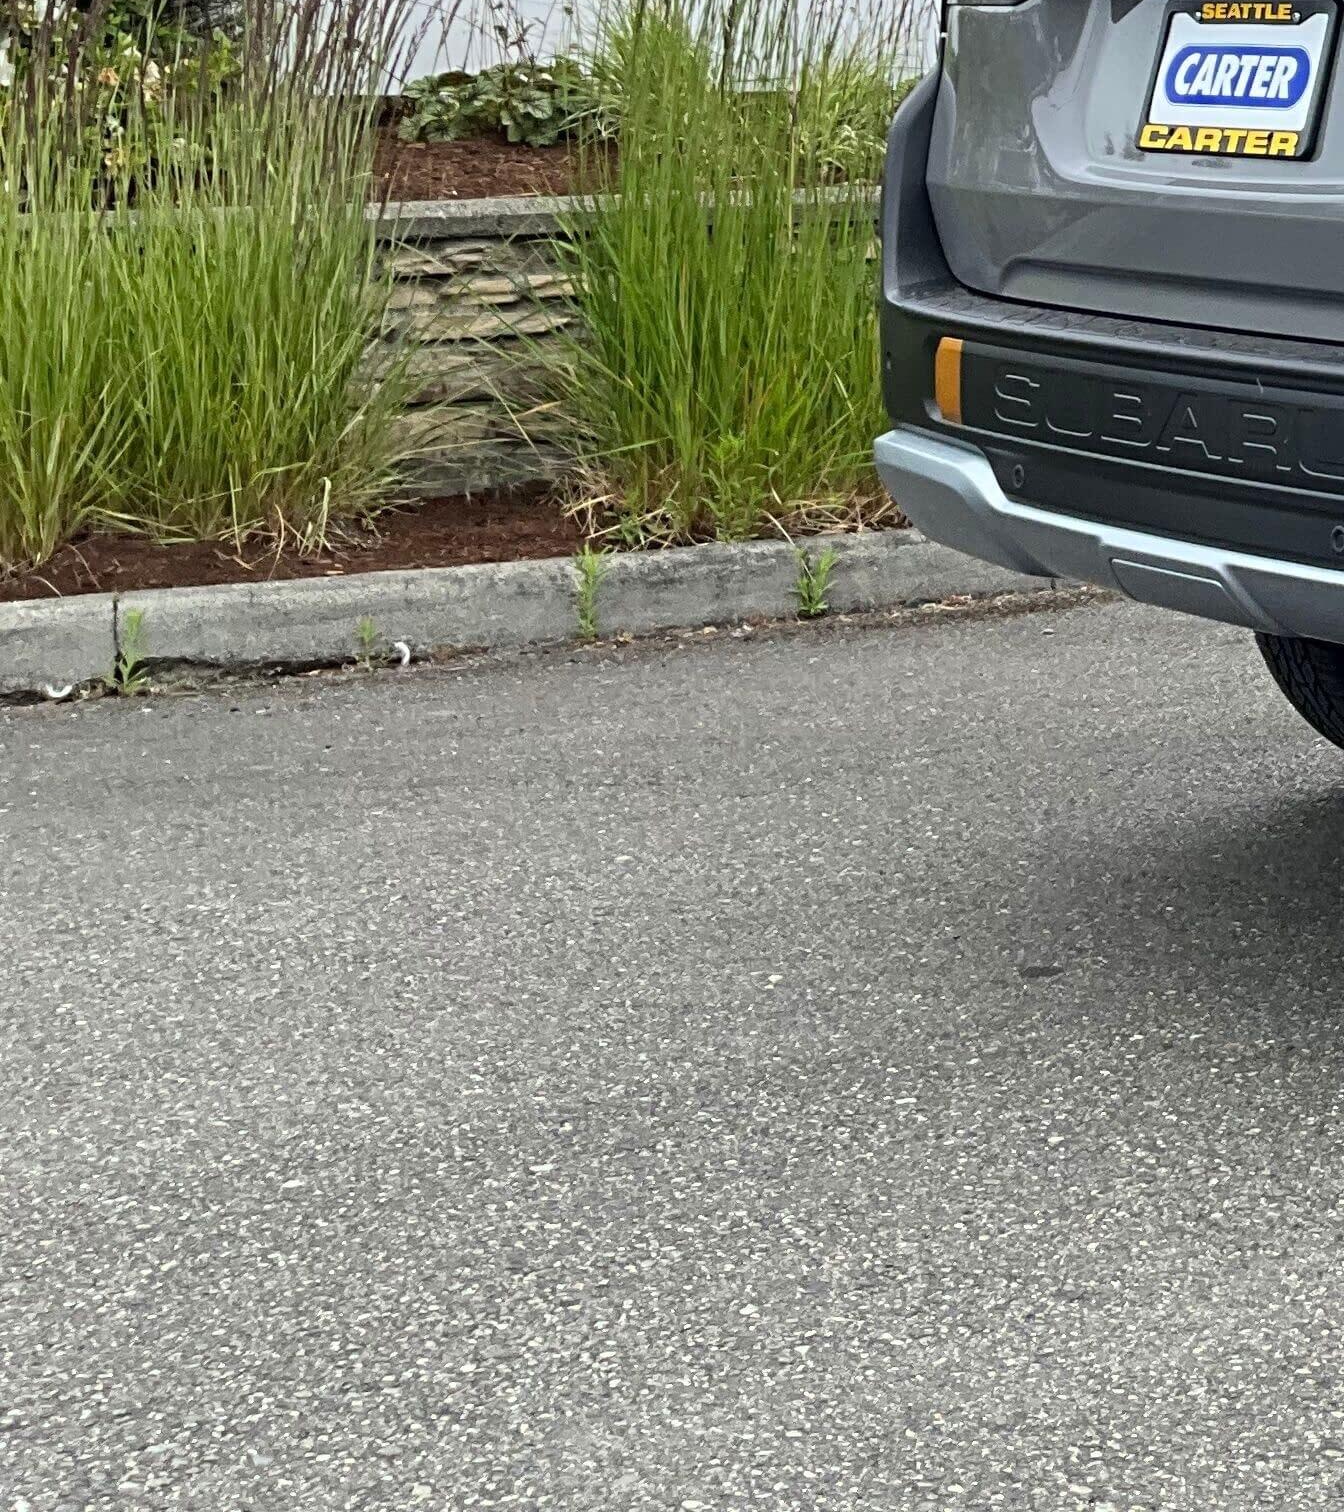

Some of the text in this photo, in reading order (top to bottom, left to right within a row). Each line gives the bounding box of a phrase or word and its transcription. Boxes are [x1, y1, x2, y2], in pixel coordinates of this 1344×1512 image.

[1202, 3, 1292, 20] SEATTLE
[1174, 52, 1298, 99] CARTER
[1139, 124, 1299, 156] CARTER
